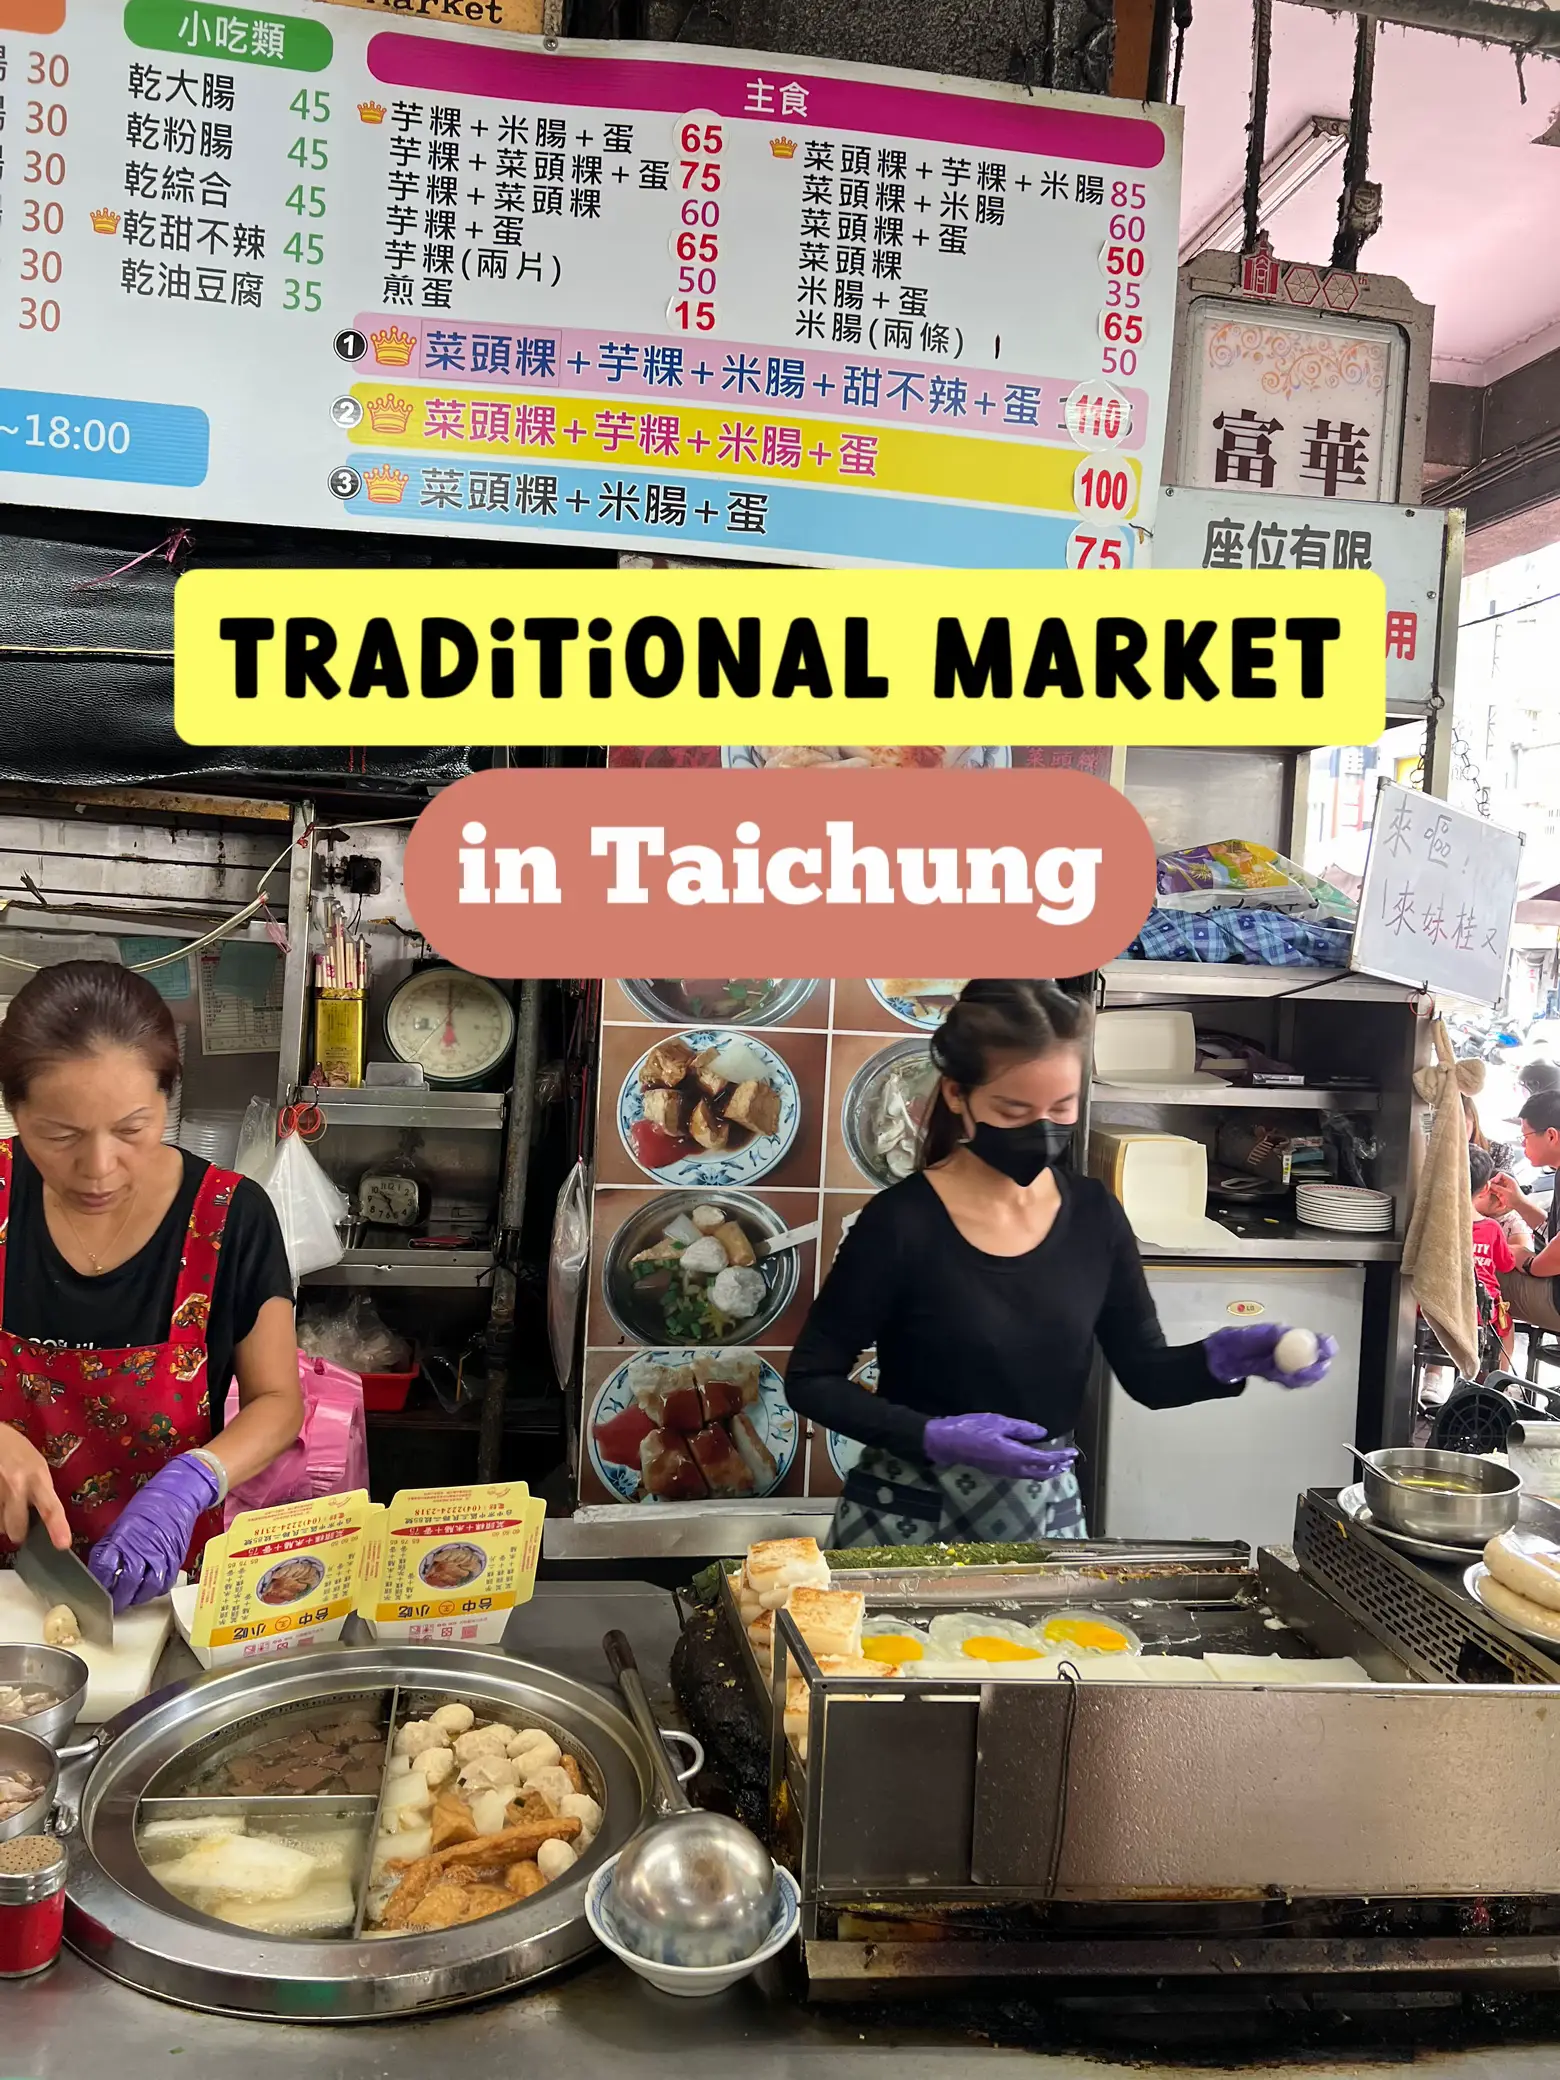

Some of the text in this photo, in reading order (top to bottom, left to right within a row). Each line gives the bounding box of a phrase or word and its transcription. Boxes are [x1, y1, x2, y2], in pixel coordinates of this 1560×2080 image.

[365, 0, 503, 24] arket
[177, 10, 287, 60] 小吃類
[27, 51, 69, 87] 30
[128, 62, 331, 123] 乾大腸 45
[744, 79, 809, 118] 主食
[25, 101, 67, 137] 30
[126, 112, 328, 170] 乾粉腸 45
[681, 124, 723, 154] 65
[23, 150, 66, 186] 30
[680, 160, 721, 192] 75
[124, 161, 327, 218] 乾綜合 45
[1111, 181, 1146, 210] 85
[21, 200, 64, 235] 30
[681, 199, 720, 227] 60
[1109, 214, 1145, 242] 60
[122, 209, 325, 266] 乾甜不辣 45
[676, 232, 718, 262] 65
[20, 249, 62, 284] 30
[799, 242, 1140, 309] 菜頭粿 35
[1106, 246, 1145, 276] 50
[121, 258, 322, 312] 乾油豆腐 35
[678, 267, 716, 294] 50
[18, 297, 61, 332] 30
[382, 274, 715, 330] 煎蛋 15
[1103, 314, 1142, 344] 65
[1102, 348, 1137, 375] 50
[1076, 395, 1120, 438] 110
[1213, 409, 1370, 496] 富華
[1081, 468, 1127, 510] 100
[1075, 535, 1121, 569] 75
[1202, 517, 1372, 569] 座位有限
[1385, 611, 1417, 660] 用
[254, 1516, 321, 1536] (04)2224-2318
[415, 1505, 482, 1516] (04)2224-2318
[299, 1607, 329, 1625] 台中
[398, 1604, 430, 1619] 小吃
[462, 1597, 492, 1612] 台中
[233, 1622, 266, 1641] 小吃
